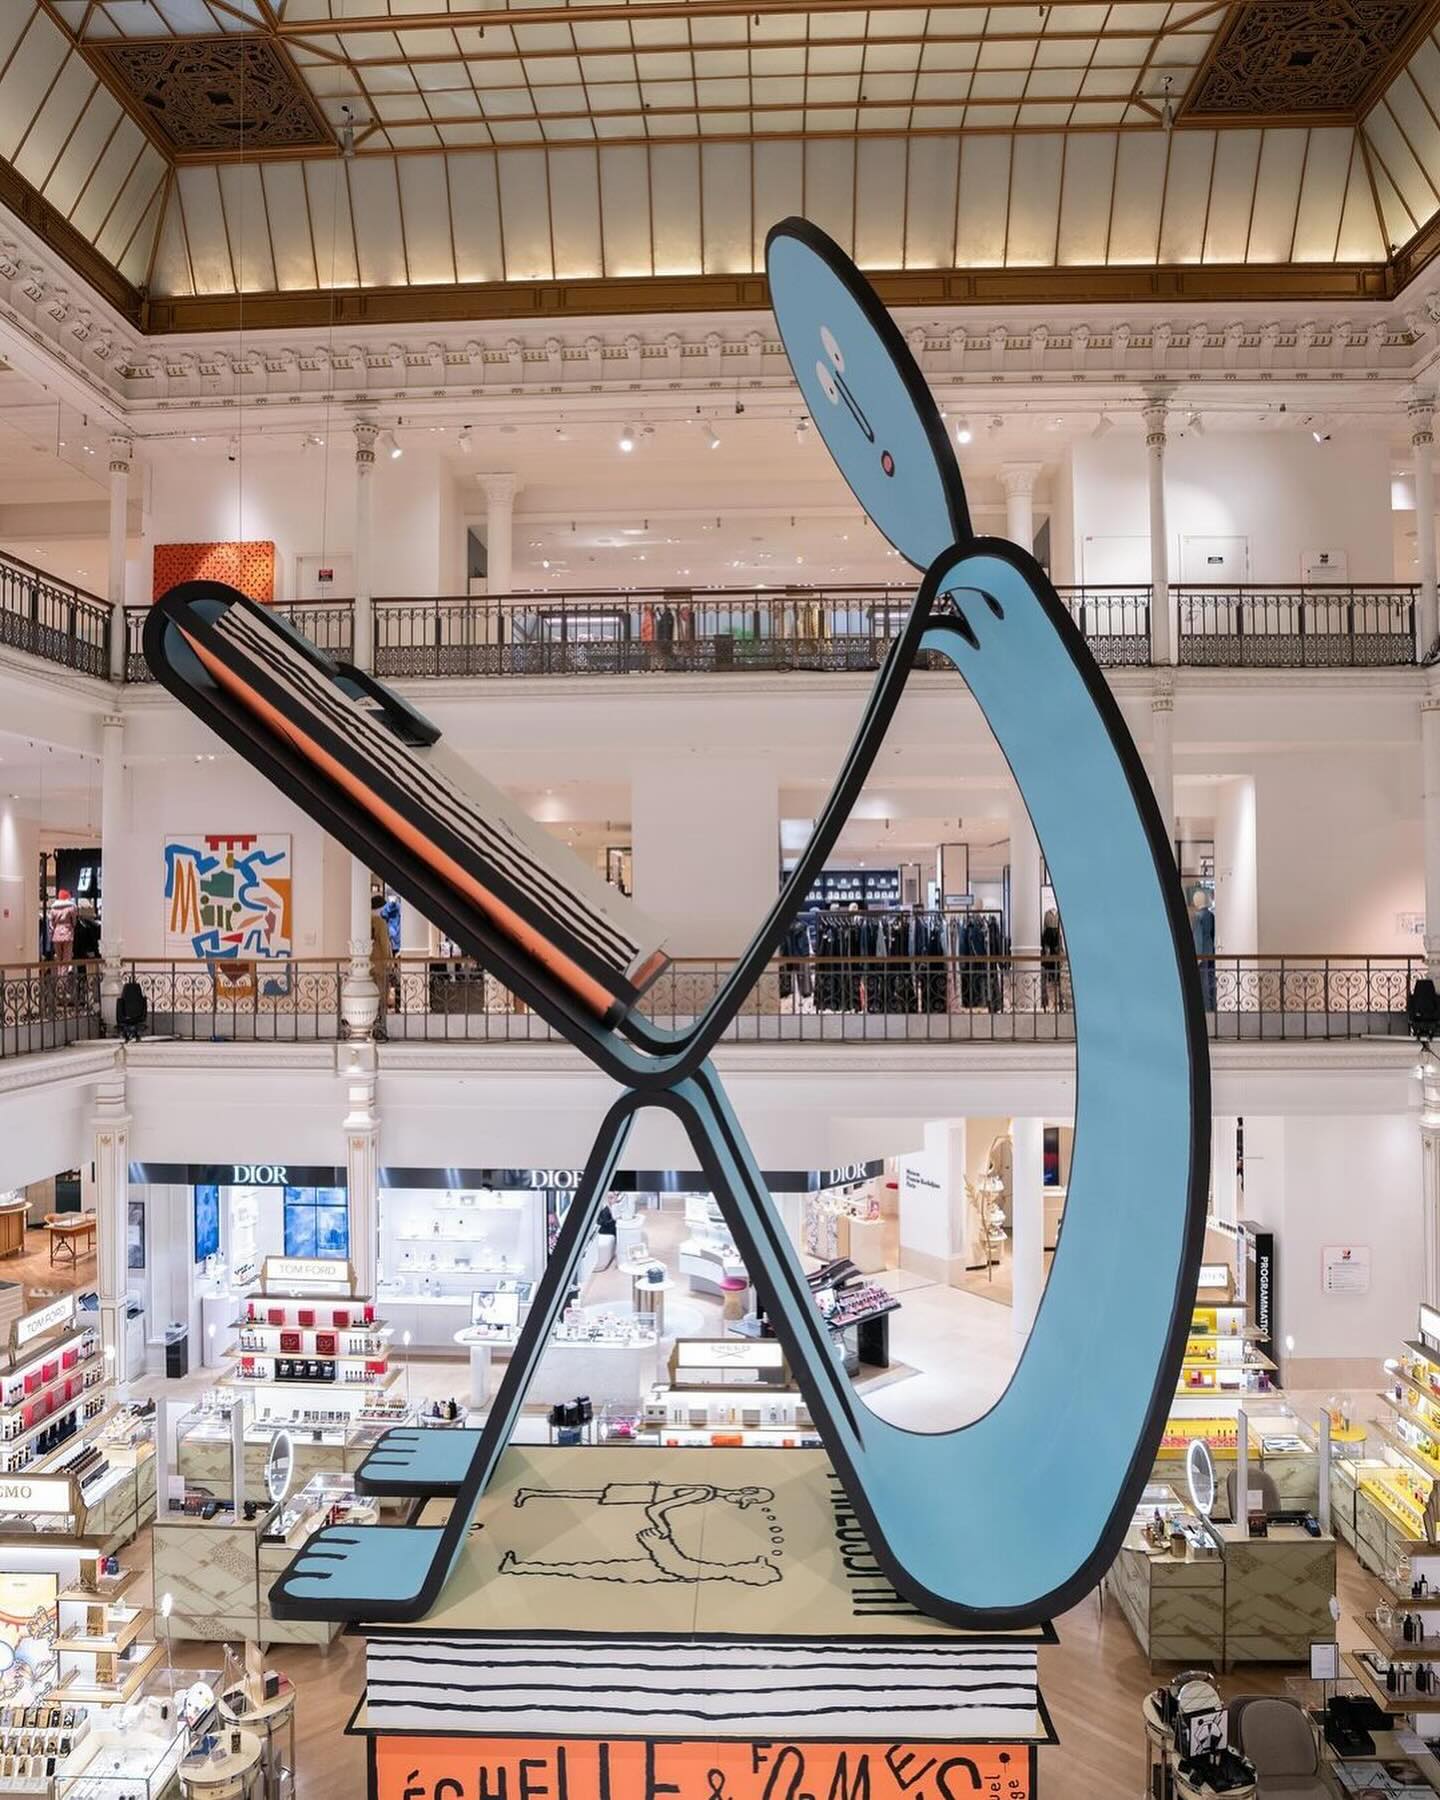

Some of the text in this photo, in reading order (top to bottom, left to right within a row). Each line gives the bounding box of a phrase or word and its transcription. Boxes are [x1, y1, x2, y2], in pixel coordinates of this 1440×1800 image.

[233, 1165, 288, 1184] DIOR
[829, 1162, 867, 1184] DIOR
[280, 1264, 336, 1275] TOM FORD
[752, 1743, 983, 1800] FOMES
